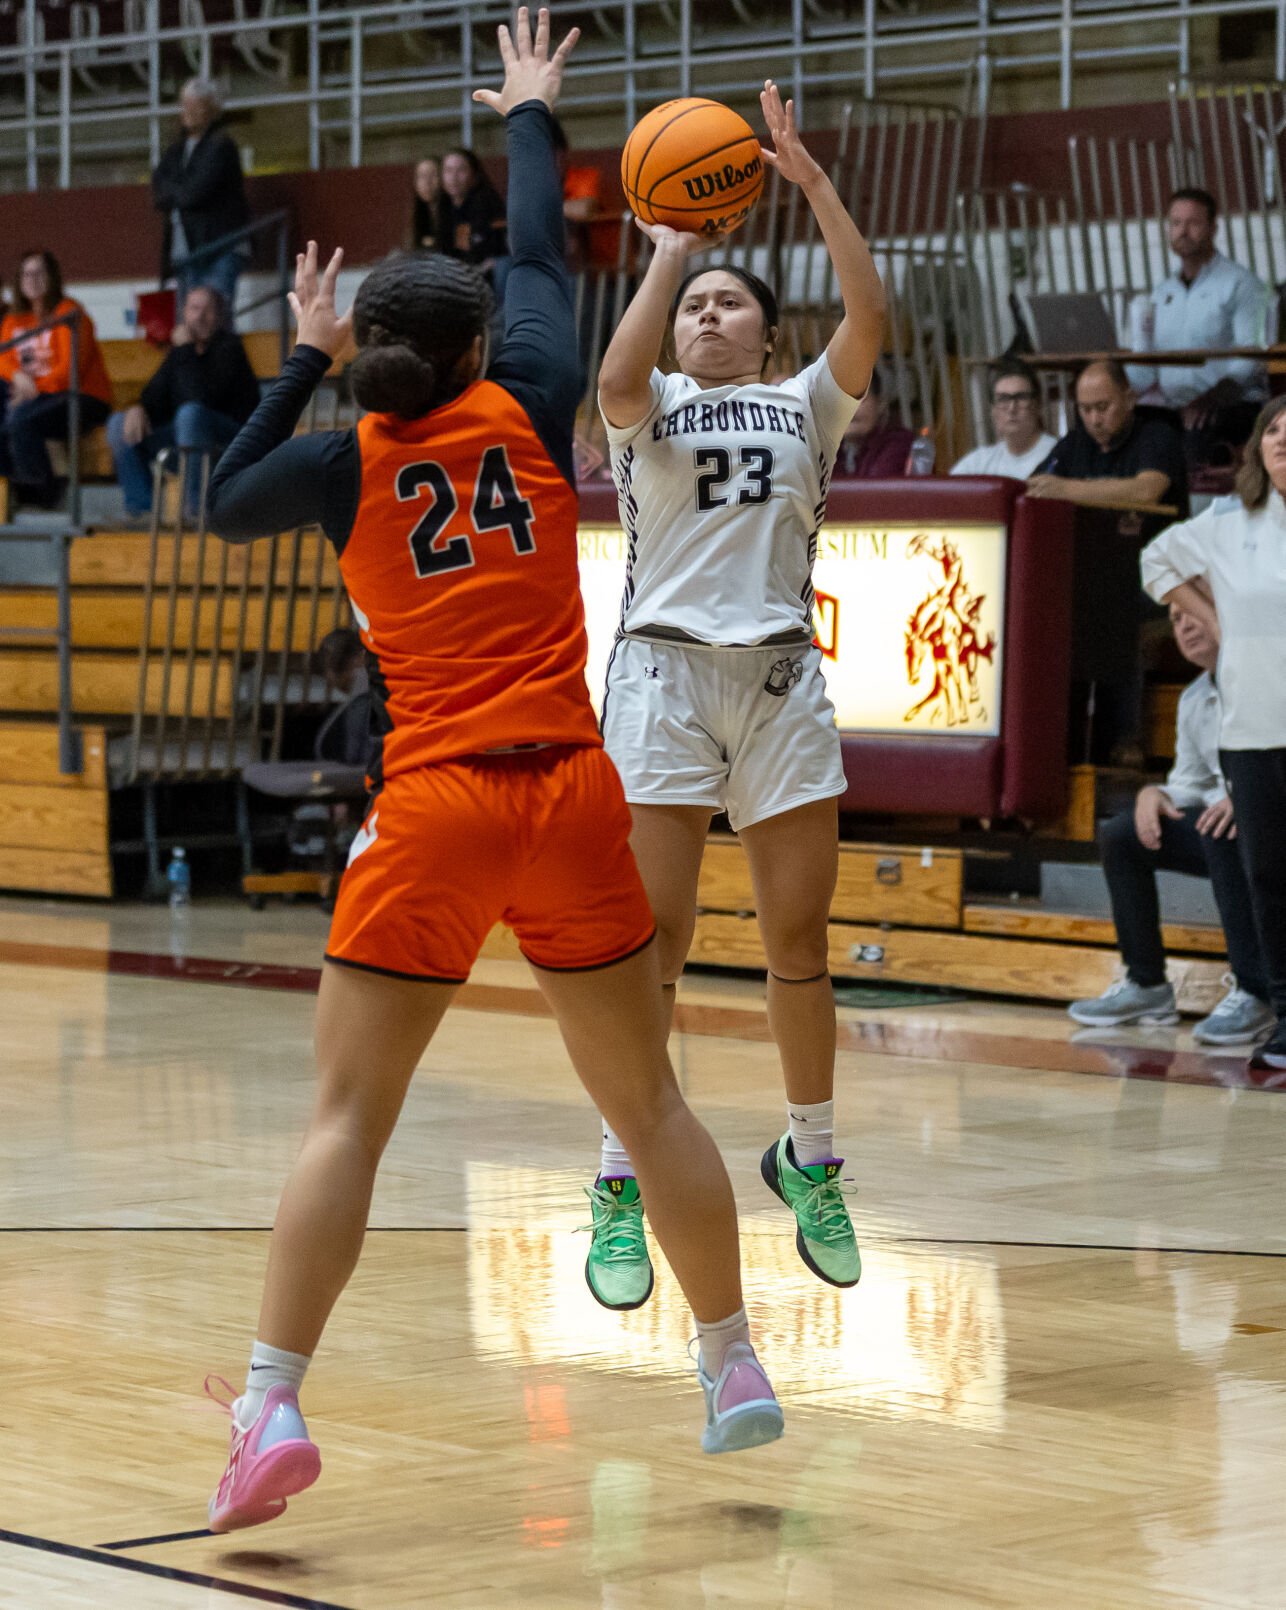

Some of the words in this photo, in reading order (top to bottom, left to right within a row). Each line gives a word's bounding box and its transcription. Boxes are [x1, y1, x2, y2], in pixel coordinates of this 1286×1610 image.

[683, 155, 762, 200] Wilson
[653, 400, 807, 444] CARBONDALE
[693, 445, 776, 513] 23
[394, 444, 537, 579] 24
